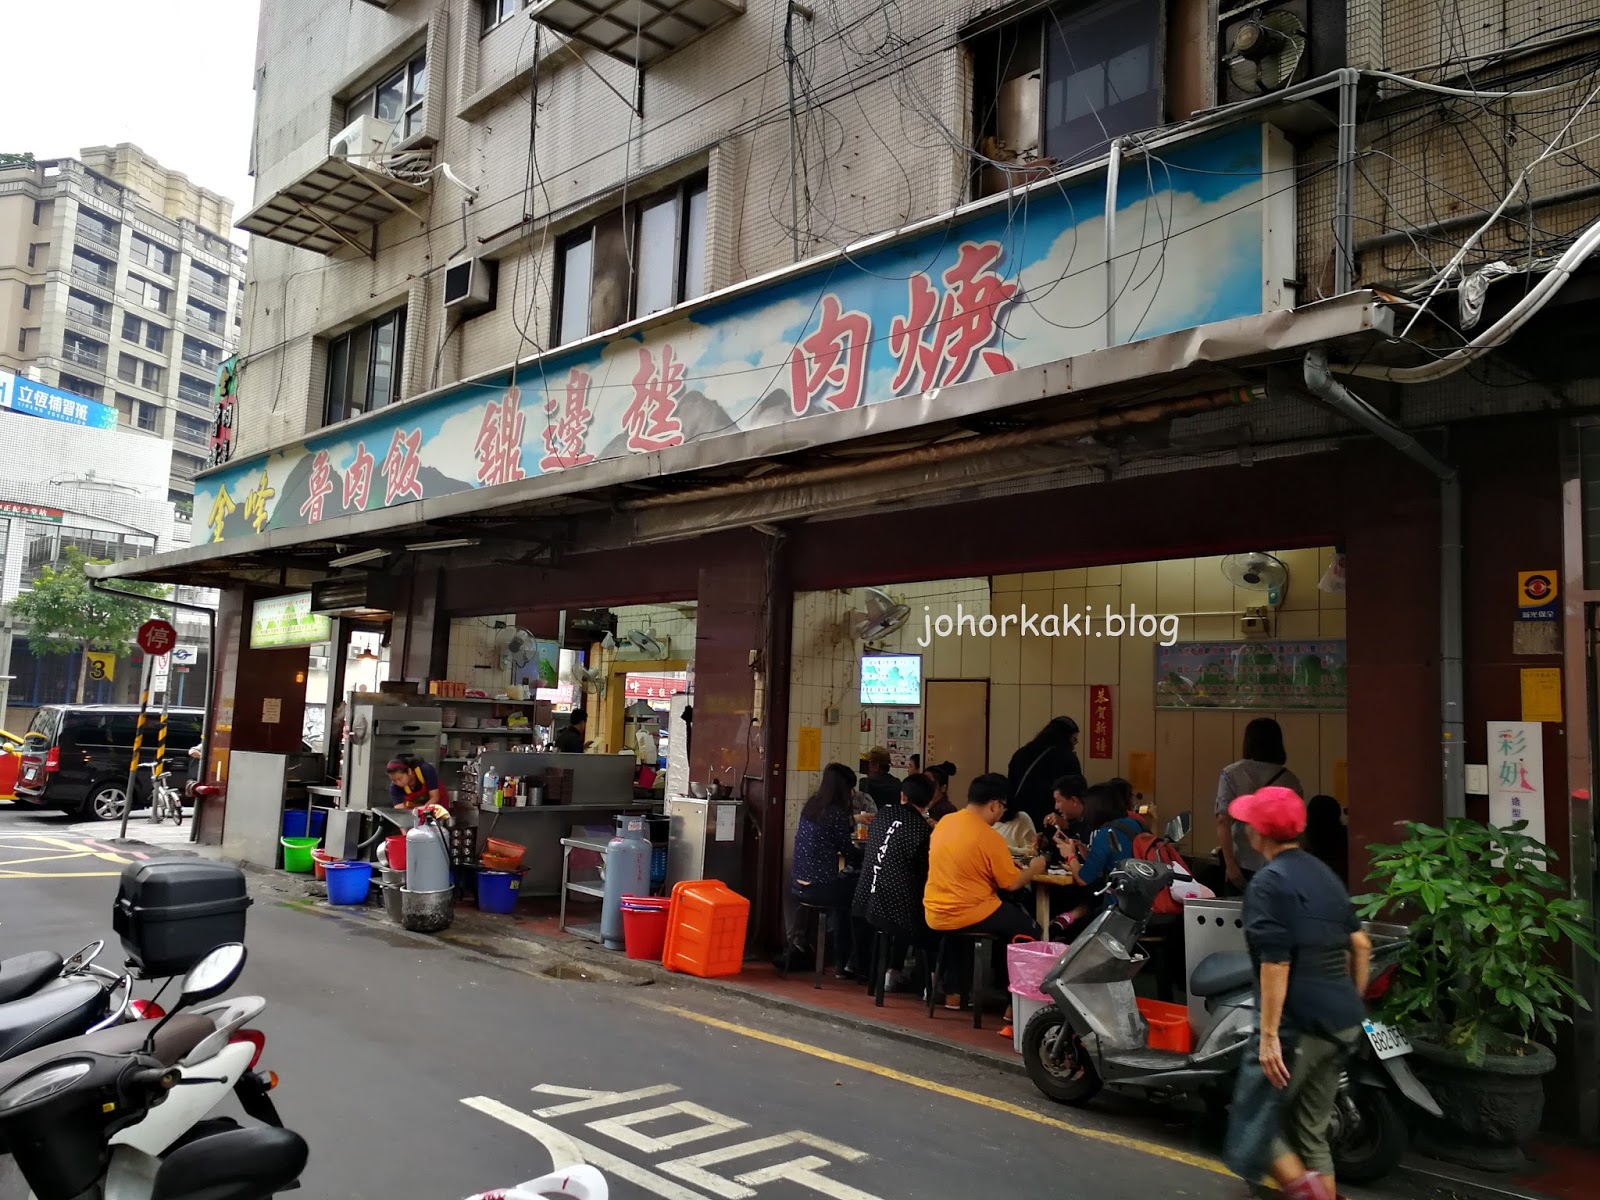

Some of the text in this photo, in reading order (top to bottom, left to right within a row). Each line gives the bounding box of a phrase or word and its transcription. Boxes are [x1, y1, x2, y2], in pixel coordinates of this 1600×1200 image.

[18, 386, 88, 420] 立恆補習班
[208, 470, 275, 542] 金峰
[300, 427, 423, 524] 魯肉飯
[146, 626, 169, 648] 停
[90, 660, 105, 680] 3
